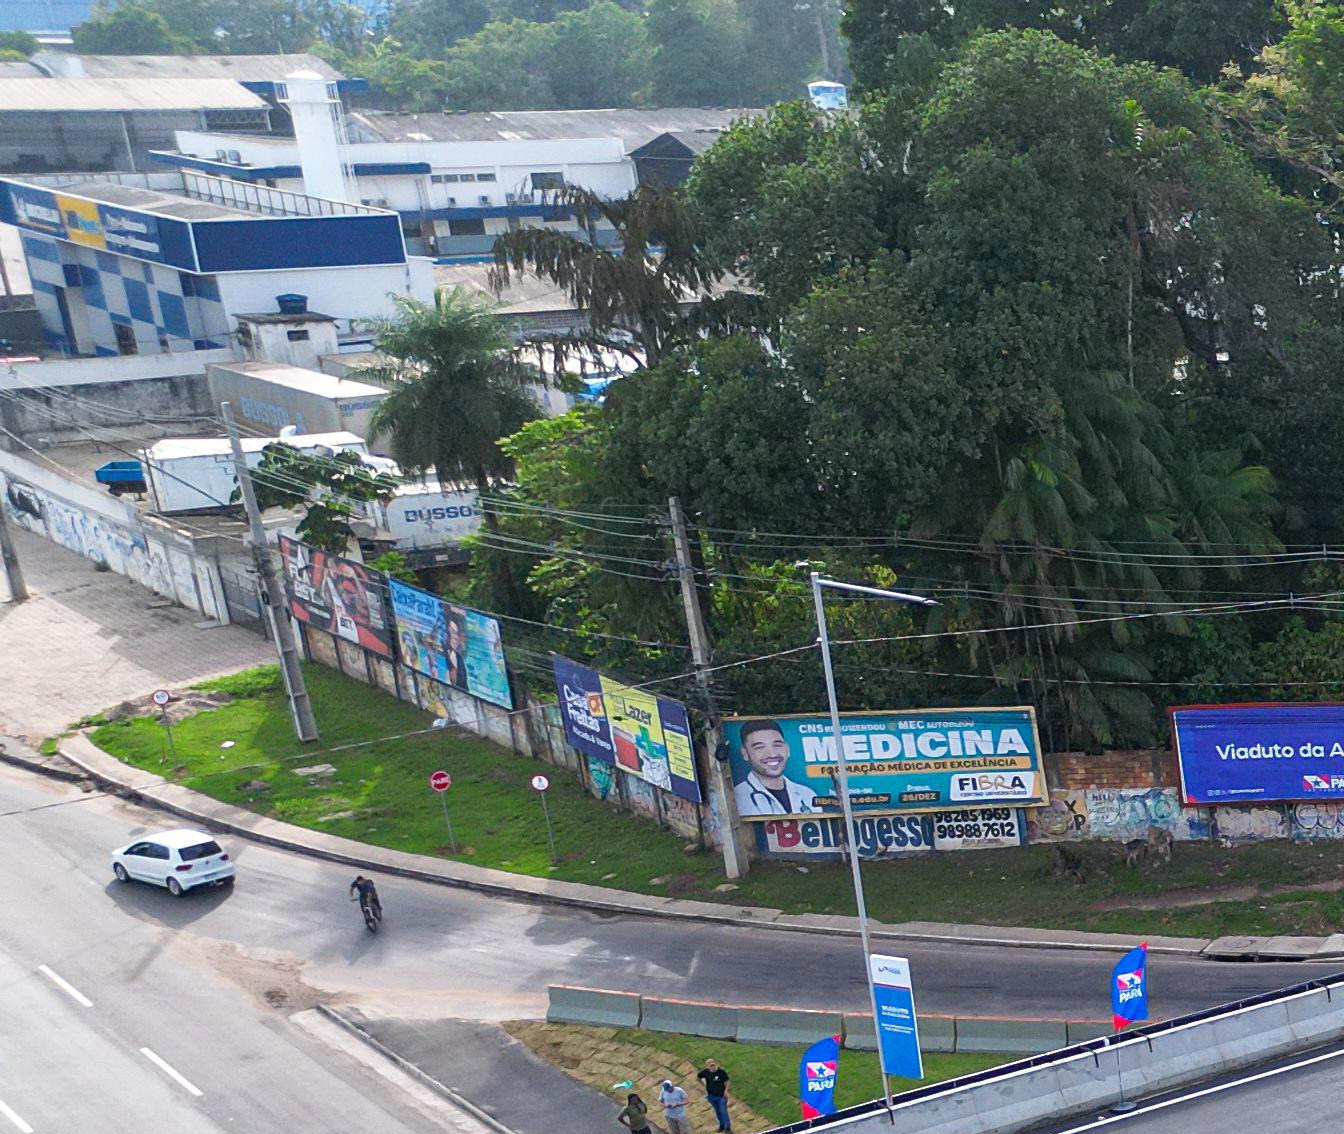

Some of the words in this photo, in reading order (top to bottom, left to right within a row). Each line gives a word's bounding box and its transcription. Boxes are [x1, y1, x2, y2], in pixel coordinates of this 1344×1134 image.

[404, 504, 481, 522] BUSSO
[799, 724, 824, 734] CNS
[824, 723, 886, 733] REOMENDOU
[898, 720, 925, 730] MEC
[802, 728, 1030, 763] MEDICINA
[1215, 742, 1294, 760] Viaduto
[1299, 741, 1325, 759] da
[888, 760, 932, 773] MÉDICA
[934, 760, 949, 770] DE
[950, 757, 1018, 769] EXCELÊNCIA
[958, 774, 1026, 792] FIBRA
[936, 821, 1016, 839] 98988-7612
